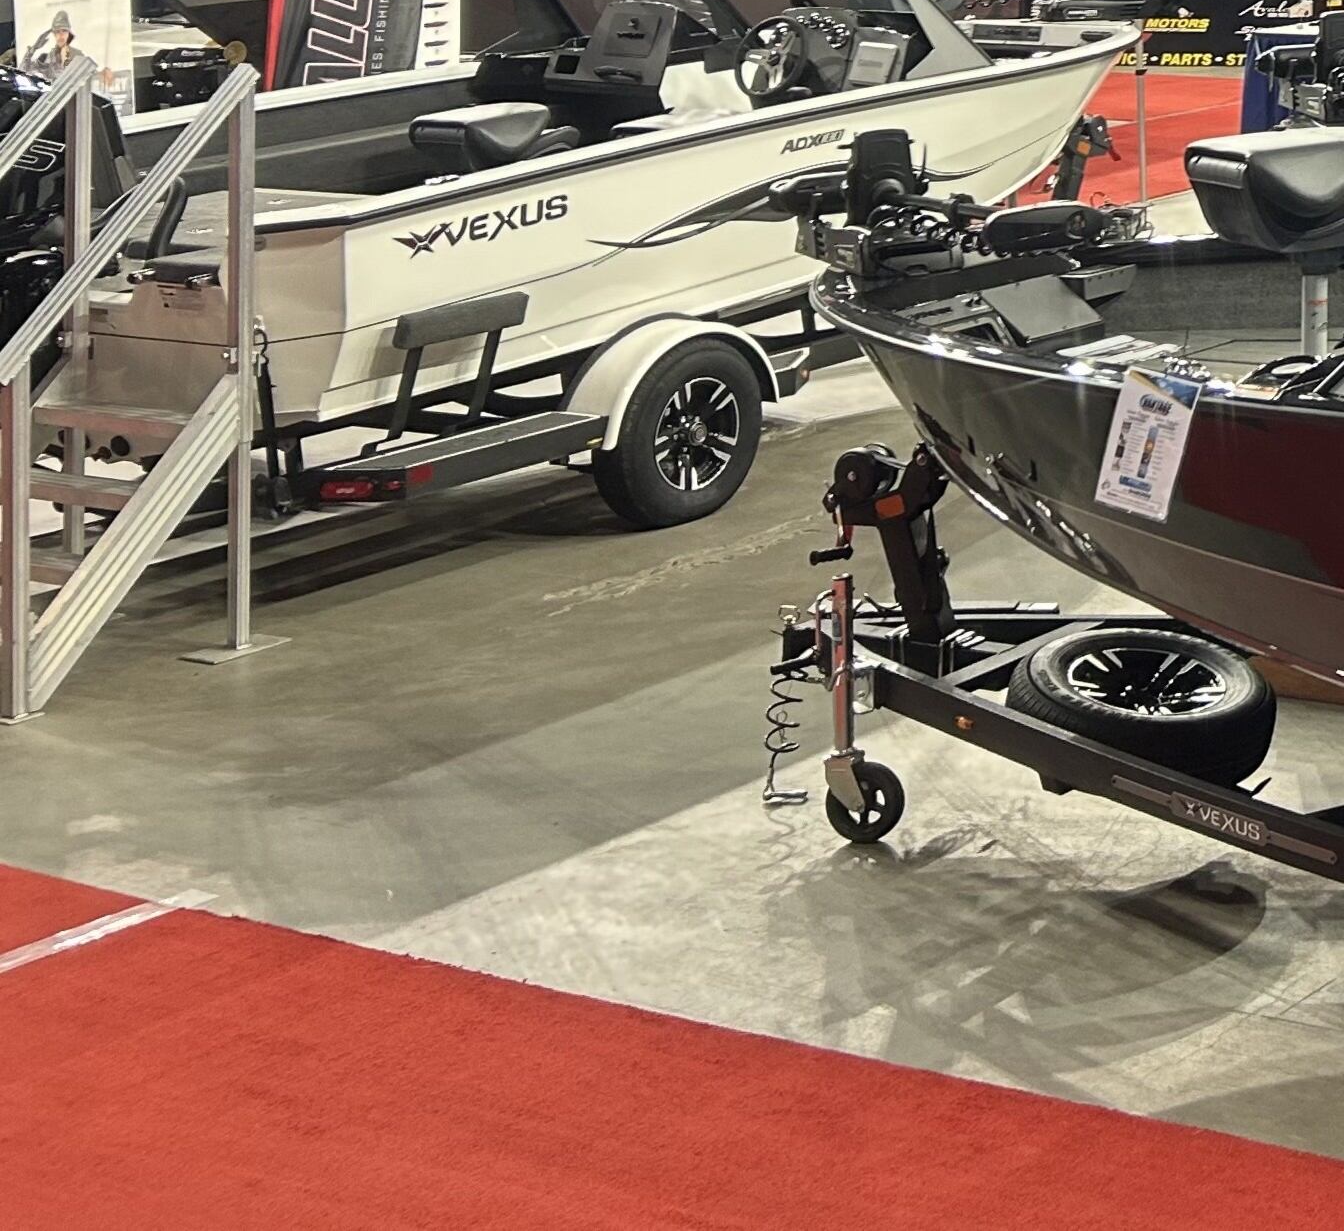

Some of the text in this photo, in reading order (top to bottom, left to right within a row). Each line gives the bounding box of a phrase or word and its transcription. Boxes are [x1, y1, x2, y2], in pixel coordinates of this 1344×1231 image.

[1145, 18, 1210, 29] MOTORS
[1161, 53, 1213, 66] PARTS
[446, 194, 568, 247] VEXUS
[1199, 804, 1261, 841] VEXUS
